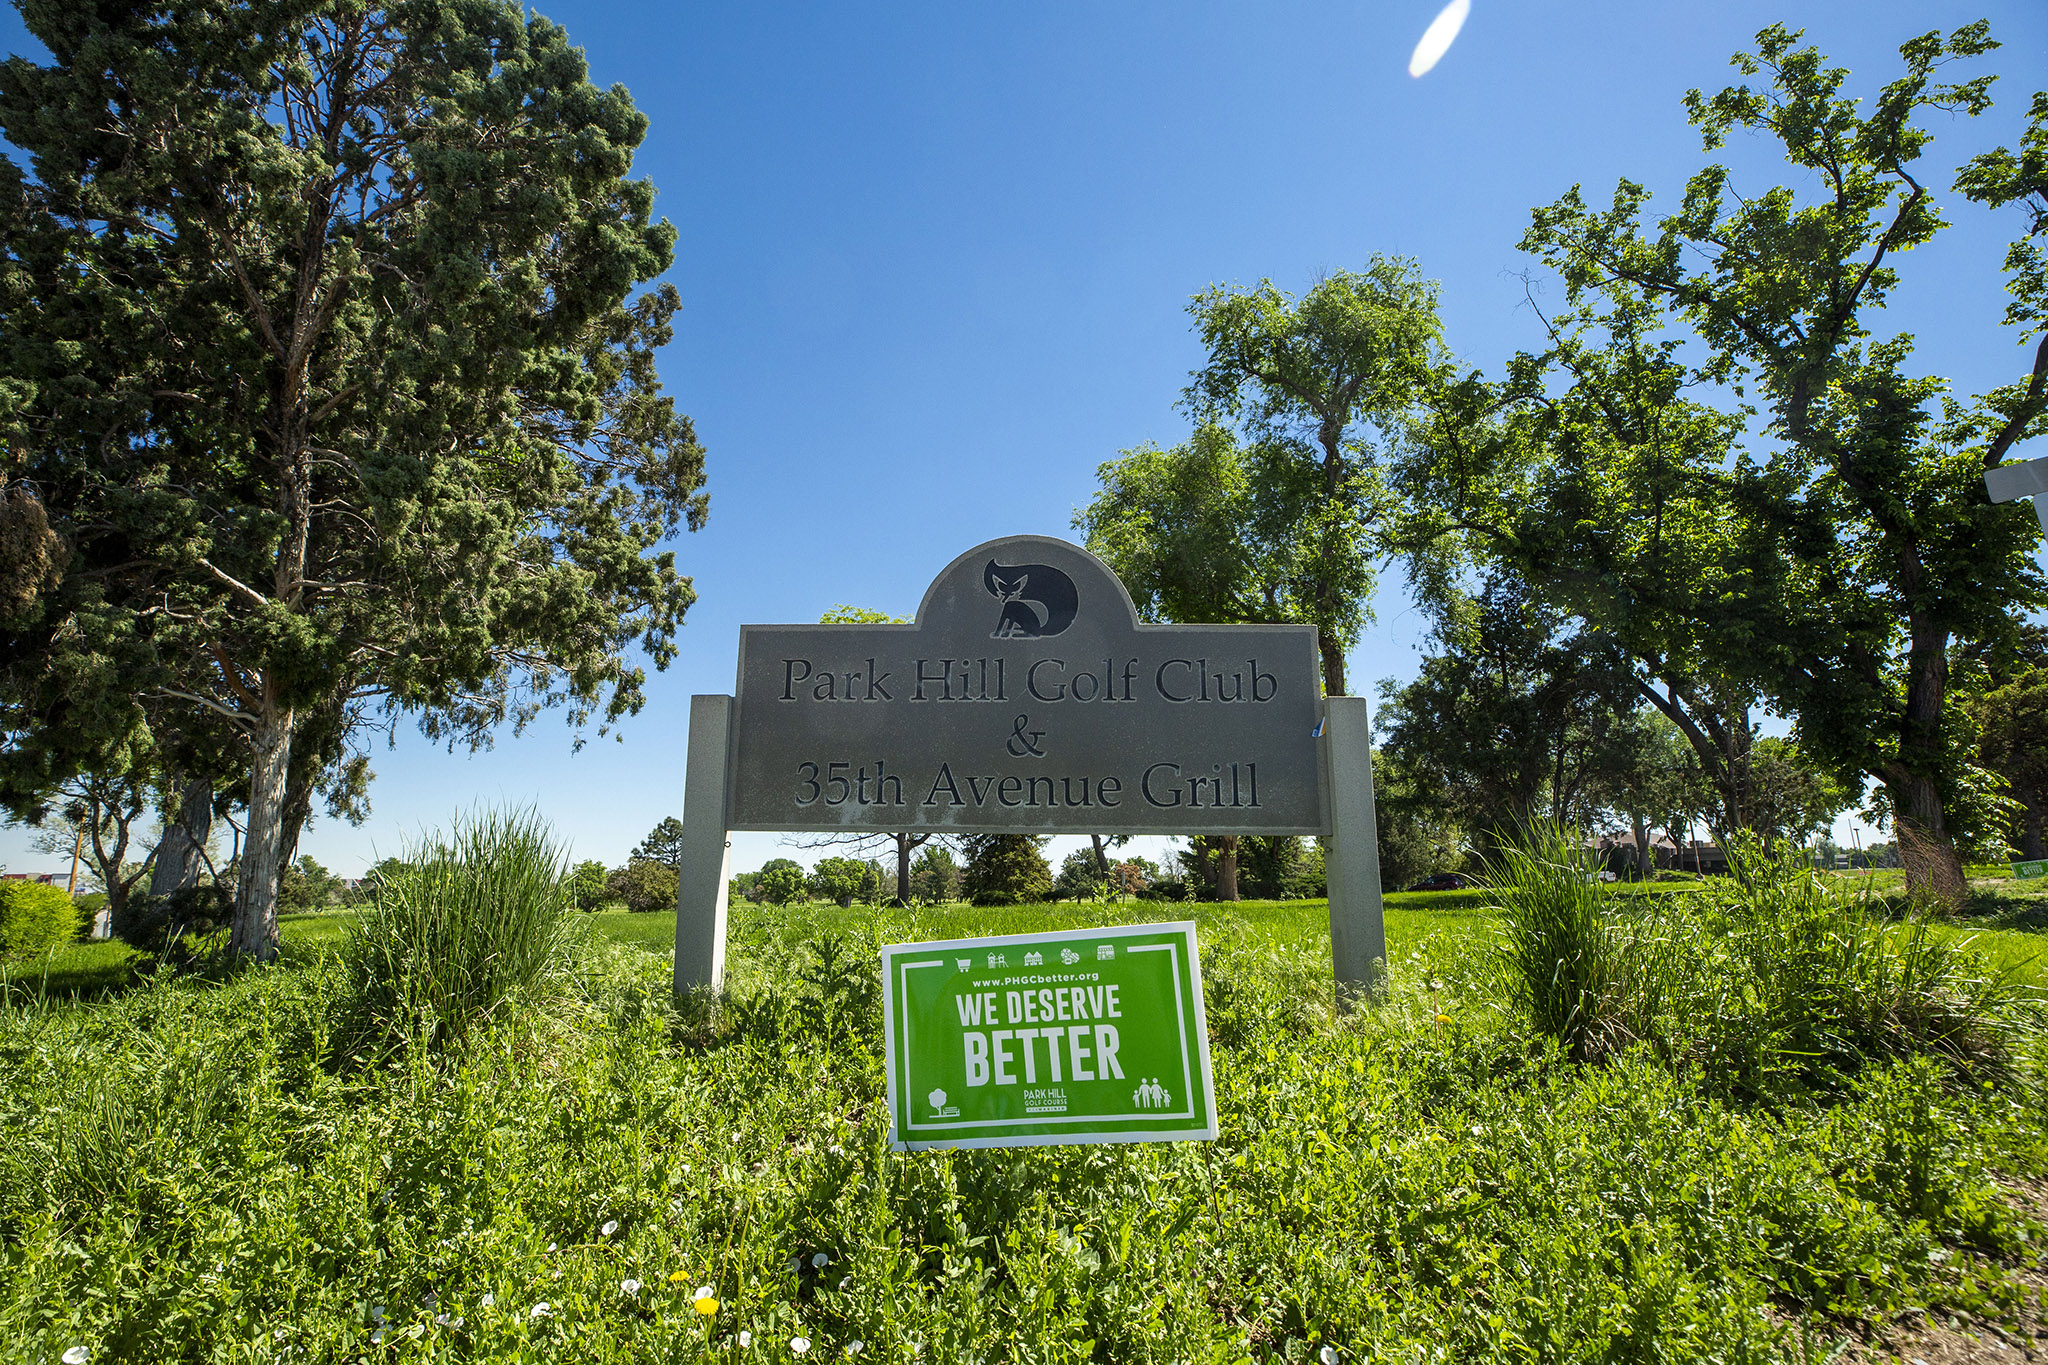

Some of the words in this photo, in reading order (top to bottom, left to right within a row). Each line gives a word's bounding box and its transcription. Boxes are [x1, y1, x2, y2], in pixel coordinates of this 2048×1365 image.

[779, 658, 892, 703] Park
[910, 657, 1008, 703] Hill
[1026, 657, 1138, 703] Golf
[1155, 657, 1278, 704] Club
[1006, 713, 1047, 758] &
[795, 760, 905, 806] 35th
[923, 761, 1122, 808] Avenue
[1141, 761, 1263, 808] Grill
[972, 972, 1100, 988] www.PHGCbetter.org
[956, 992, 998, 1027] WE
[1006, 984, 1122, 1024] DESERVE
[963, 1024, 1126, 1087] BETTER
[1023, 1089, 1047, 1100] PARK
[1047, 1088, 1067, 1099] HILL
